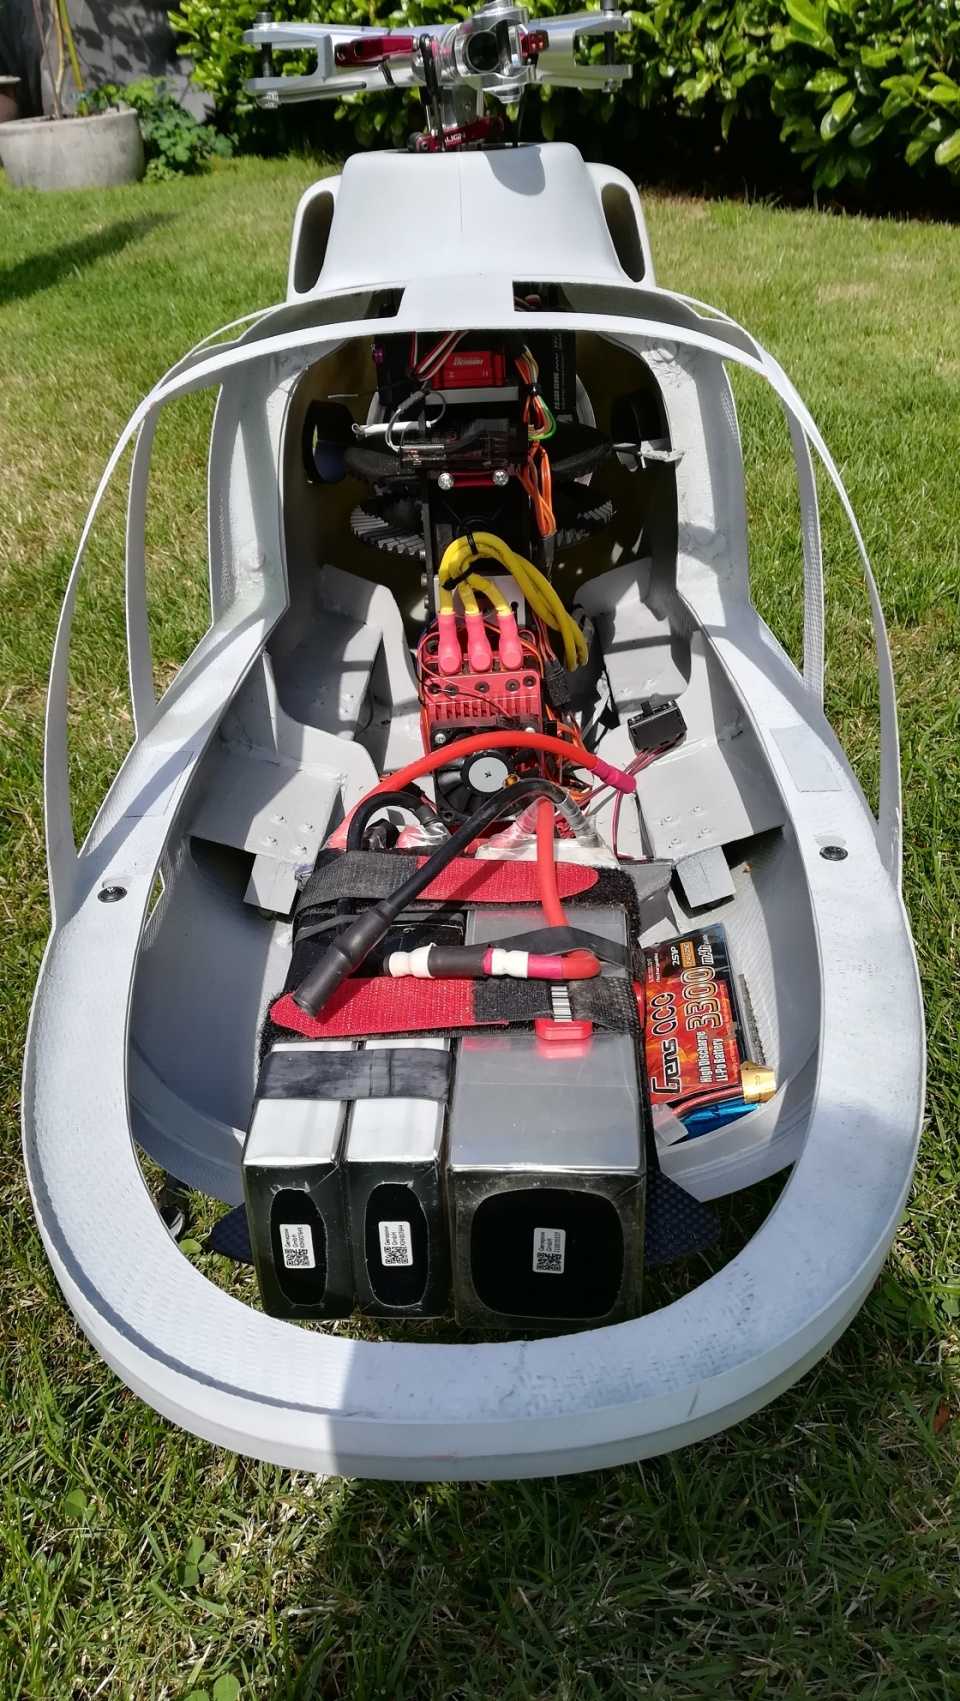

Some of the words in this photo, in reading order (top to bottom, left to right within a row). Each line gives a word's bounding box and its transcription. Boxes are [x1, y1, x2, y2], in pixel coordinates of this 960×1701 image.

[681, 966, 723, 1031] 3300
[695, 1031, 710, 1065] Discharge
[712, 1038, 727, 1063] Battery
[651, 1038, 681, 1095] Gens
[698, 1065, 713, 1083] High
